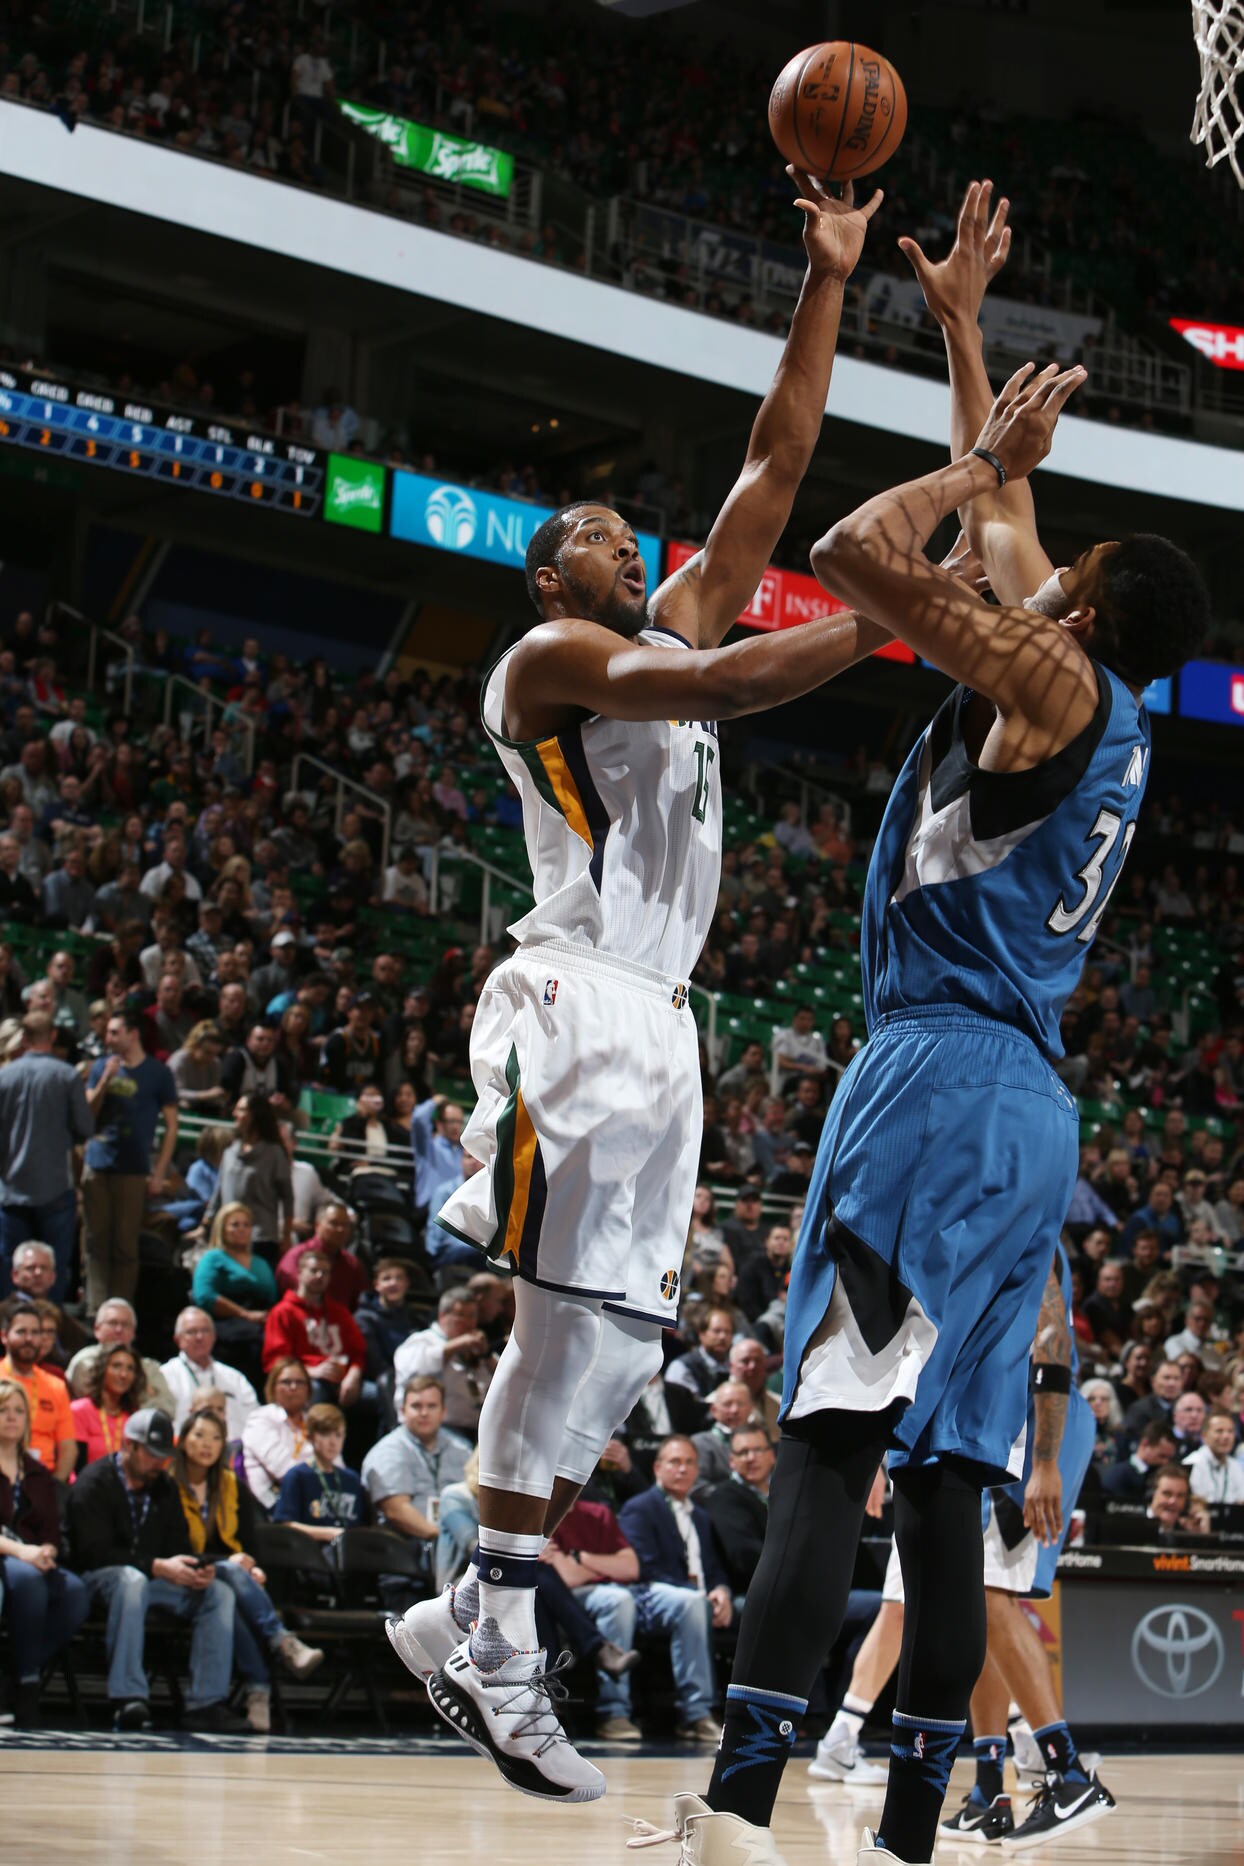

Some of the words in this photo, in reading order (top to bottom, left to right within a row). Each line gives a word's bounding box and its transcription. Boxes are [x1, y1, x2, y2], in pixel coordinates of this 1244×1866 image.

[846, 57, 880, 151] SPALDING
[87, 414, 99, 432] 4
[254, 456, 265, 474] 2
[124, 403, 153, 423] REB
[166, 414, 194, 433] AST
[207, 425, 233, 445] STL
[247, 435, 275, 455] BLK
[288, 445, 316, 465] TOV
[210, 471, 223, 489] 0
